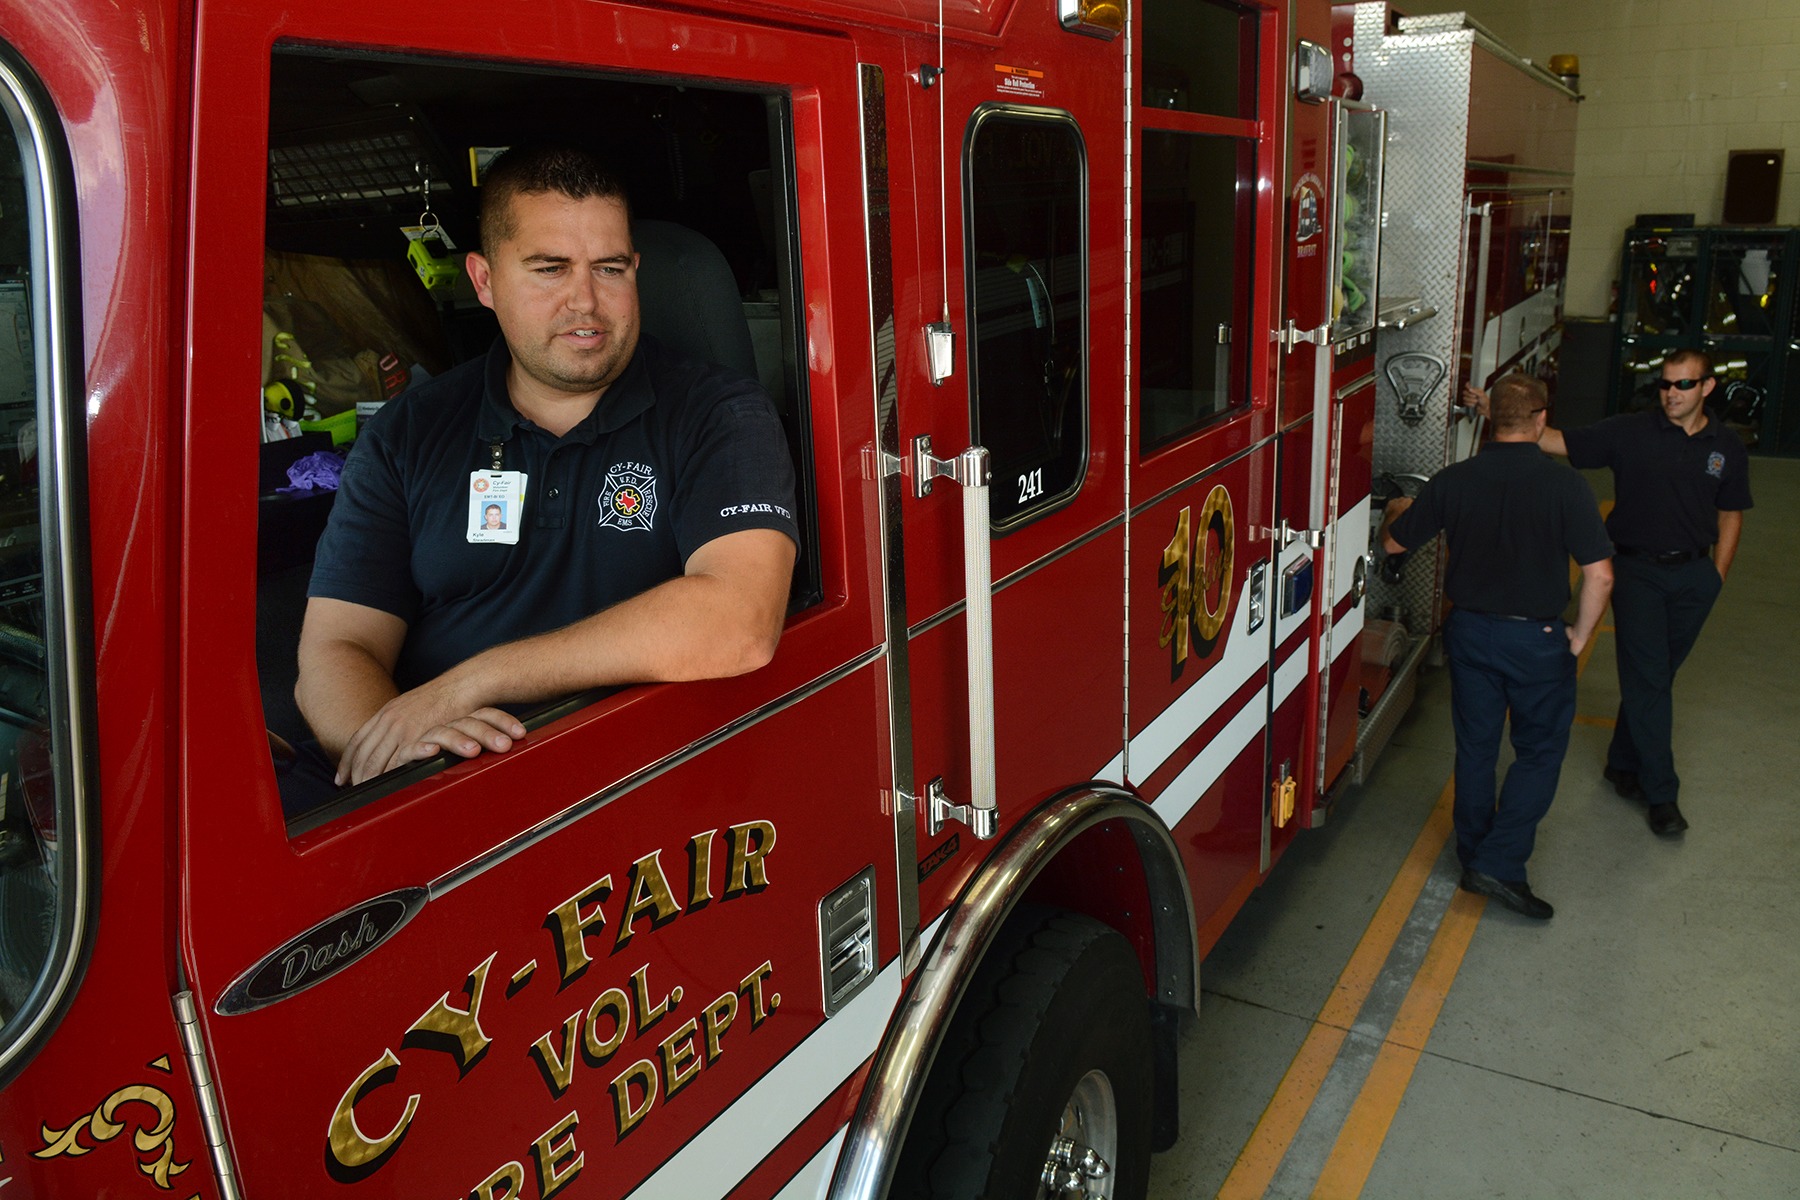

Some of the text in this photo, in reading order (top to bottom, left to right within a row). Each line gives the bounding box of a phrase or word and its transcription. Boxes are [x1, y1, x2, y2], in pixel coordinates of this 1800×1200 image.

[609, 462, 653, 476] CY-FAIR
[1018, 467, 1044, 504] 241
[602, 490, 612, 508] FIRE
[642, 489, 654, 518] RESCUE
[720, 503, 773, 517] CY-FAIR
[617, 518, 633, 527] EMS
[1163, 484, 1235, 665] 10
[281, 912, 379, 989] Dash
[327, 819, 778, 1172] CY-FAIR
[529, 962, 685, 1092] VOL.
[609, 960, 782, 1138] DEPT.
